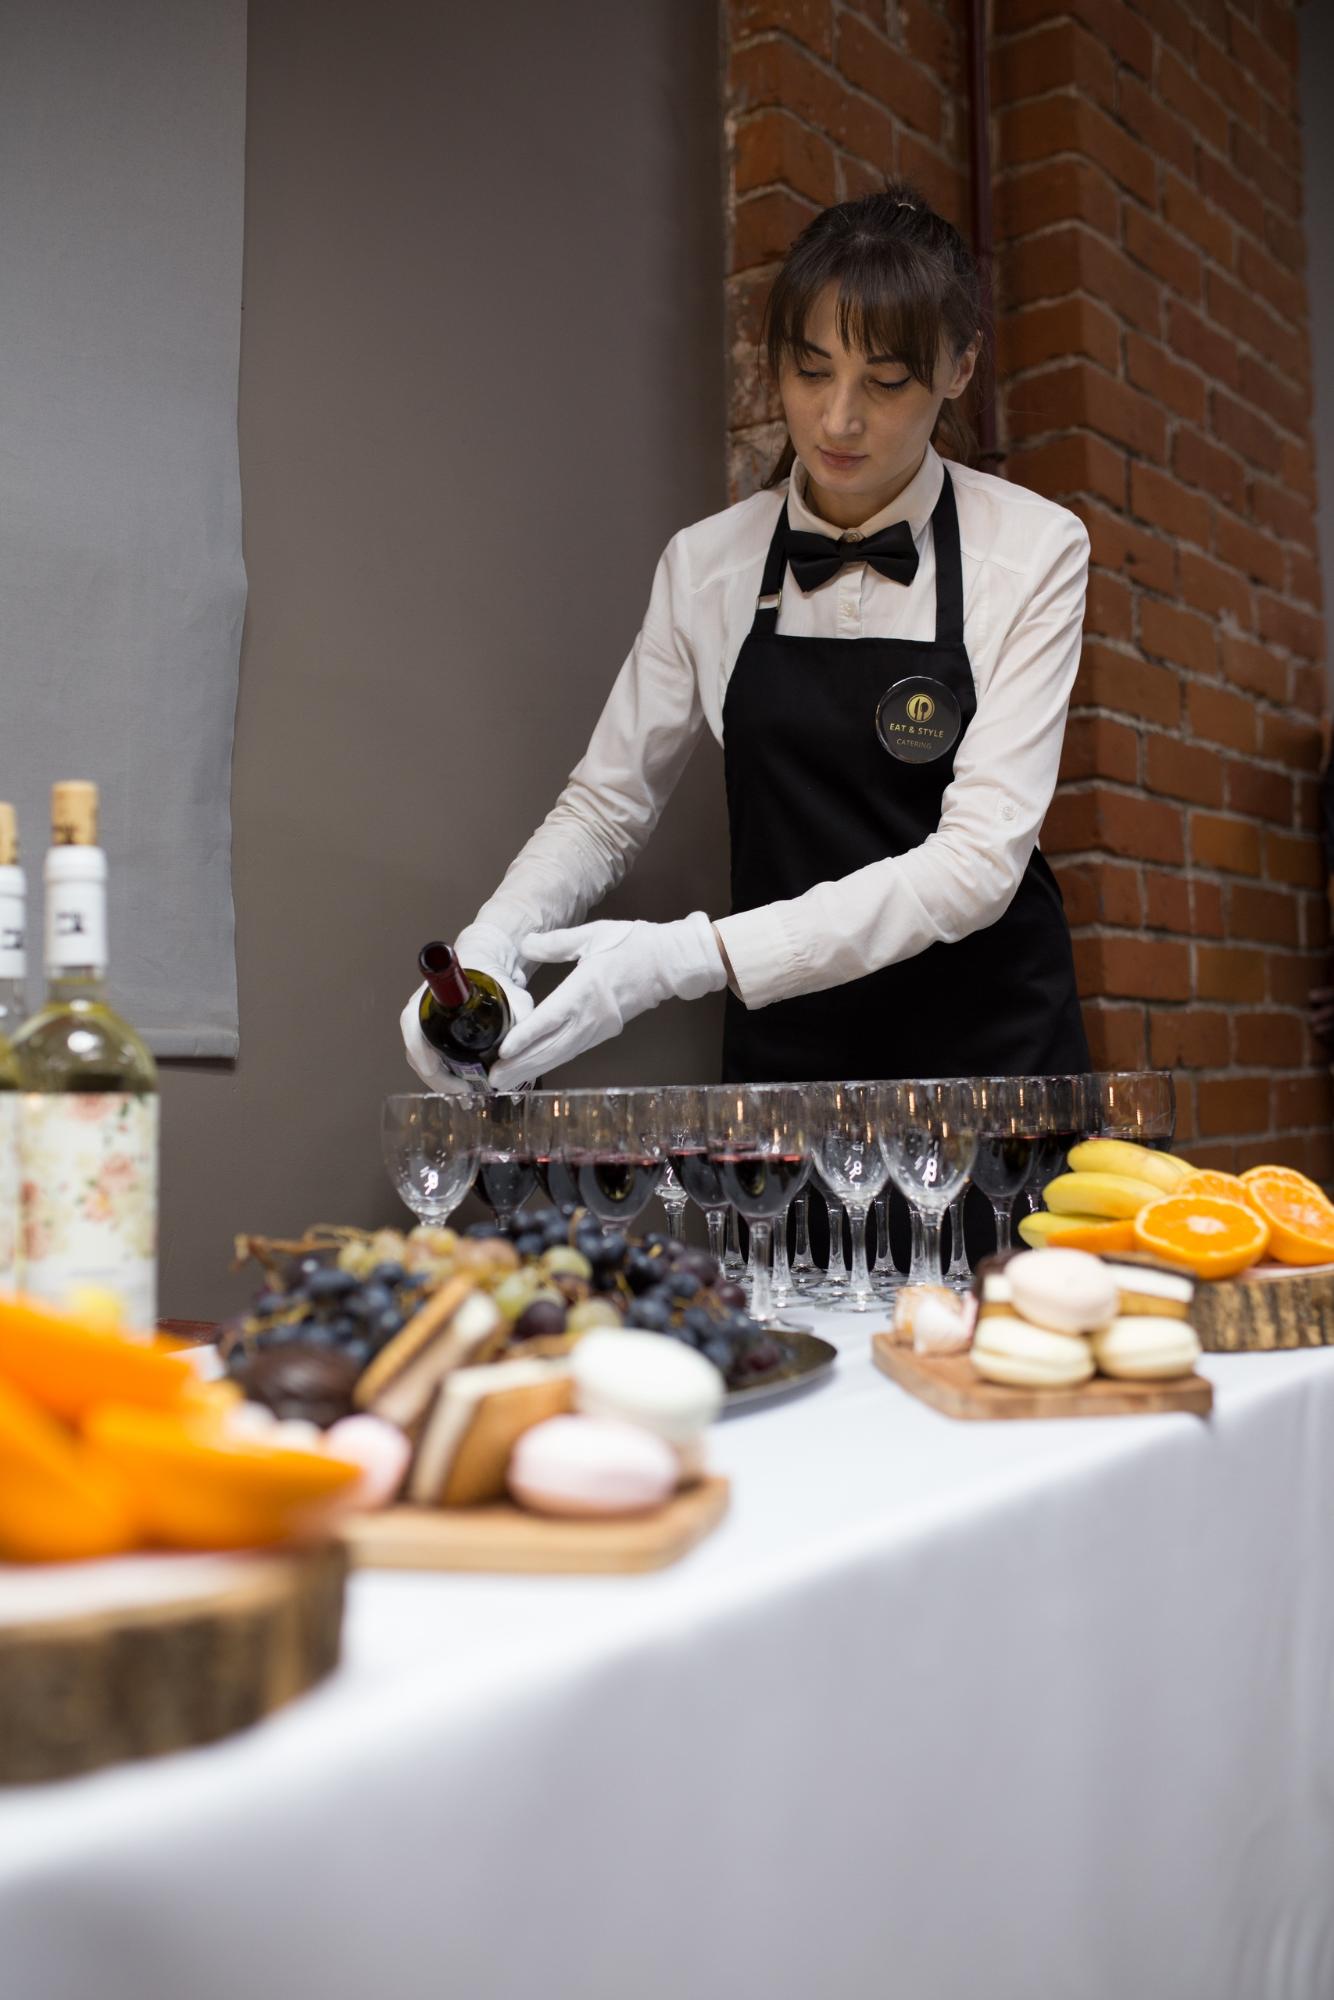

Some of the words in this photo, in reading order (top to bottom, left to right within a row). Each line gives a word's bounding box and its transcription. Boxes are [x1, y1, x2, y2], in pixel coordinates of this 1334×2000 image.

[889, 723, 907, 731] EAT
[908, 726, 915, 734] &
[917, 727, 944, 738] STYLE
[896, 738, 932, 749] CATERING
